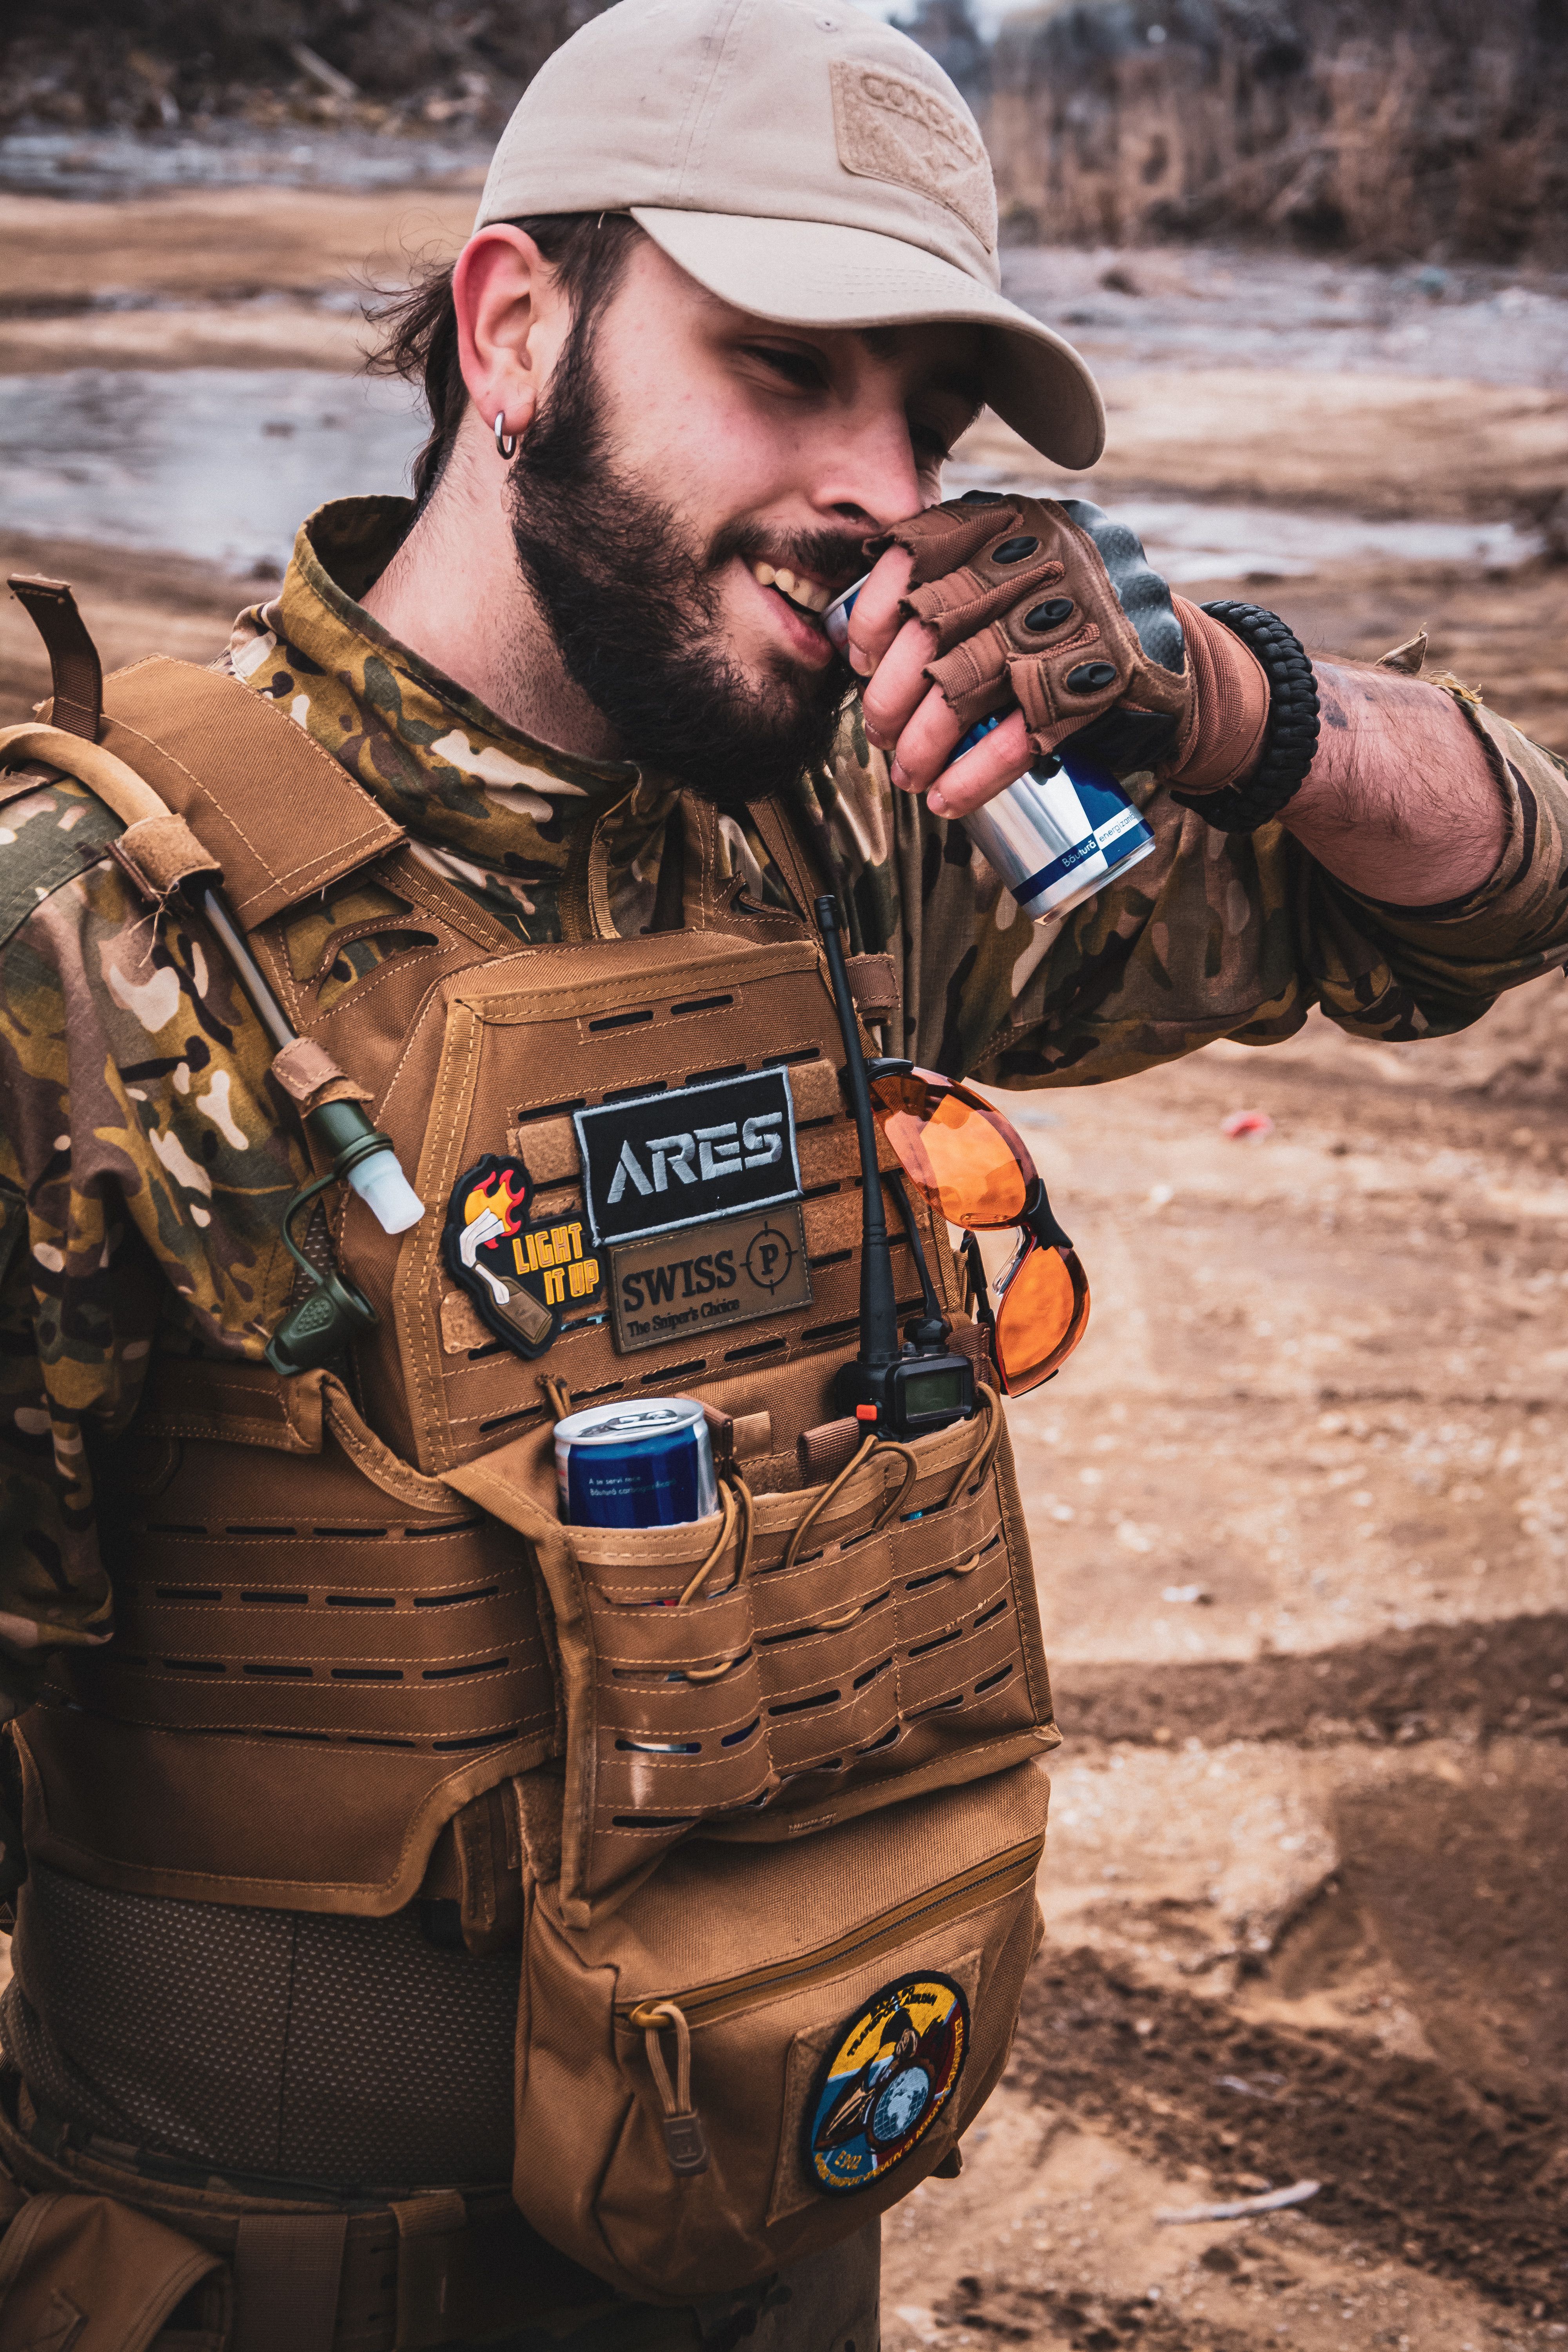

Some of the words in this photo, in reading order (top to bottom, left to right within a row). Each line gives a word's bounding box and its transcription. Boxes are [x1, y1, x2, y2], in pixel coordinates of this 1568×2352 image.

[1062, 839, 1097, 867] Băutură
[1099, 812, 1136, 842] energizantă
[607, 1112, 783, 1204] ARES
[512, 1222, 583, 1275] LIGHT
[544, 1268, 565, 1305] IT
[568, 1259, 599, 1297] UP
[622, 1250, 736, 1312] SWISS
[760, 1243, 779, 1275] P
[627, 1321, 650, 1337] The
[652, 1307, 699, 1330] Sniper's
[700, 1298, 740, 1318] Choice
